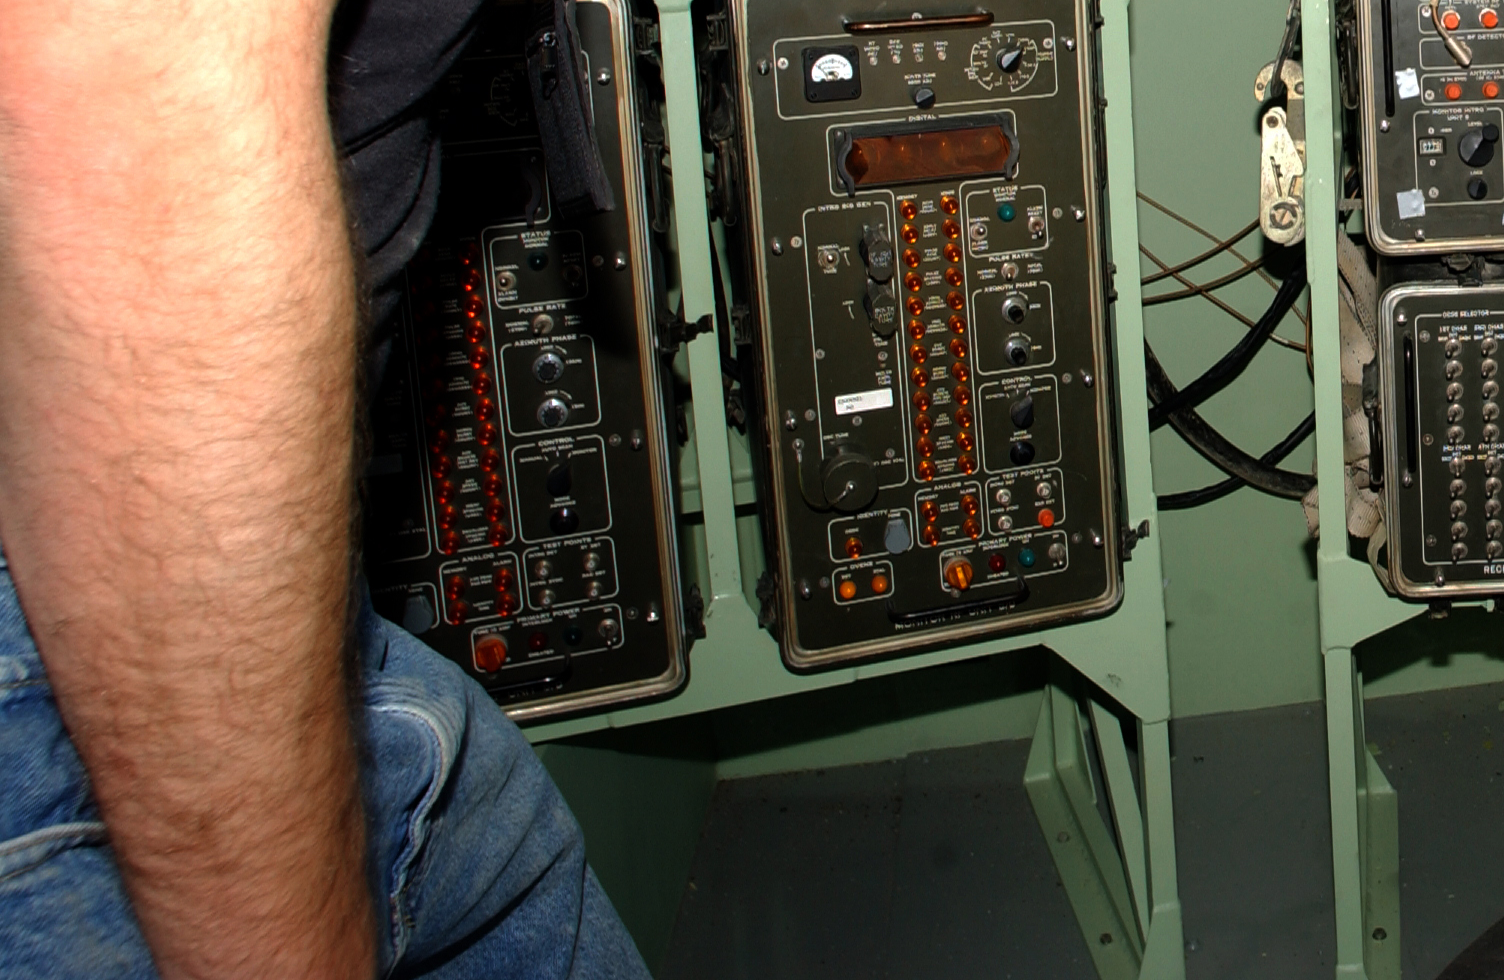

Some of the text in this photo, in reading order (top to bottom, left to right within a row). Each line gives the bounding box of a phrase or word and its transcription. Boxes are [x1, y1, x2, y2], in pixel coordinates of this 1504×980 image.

[908, 114, 938, 122] DIGITAL
[993, 185, 1019, 193] STATUS
[520, 229, 551, 239] STATUS
[518, 302, 567, 314] PULSE RATE
[514, 333, 577, 347] AZIMUTH PHASE
[1001, 376, 1033, 385] CONTROL
[538, 436, 575, 447] CONTROL
[1002, 472, 1018, 480] TEST
[934, 482, 962, 491] ANALOG
[542, 536, 592, 549] TEST POINTS
[1009, 533, 1033, 543] POWER
[461, 552, 495, 564] ANALOG
[516, 607, 581, 624] PRIMARY POWER
